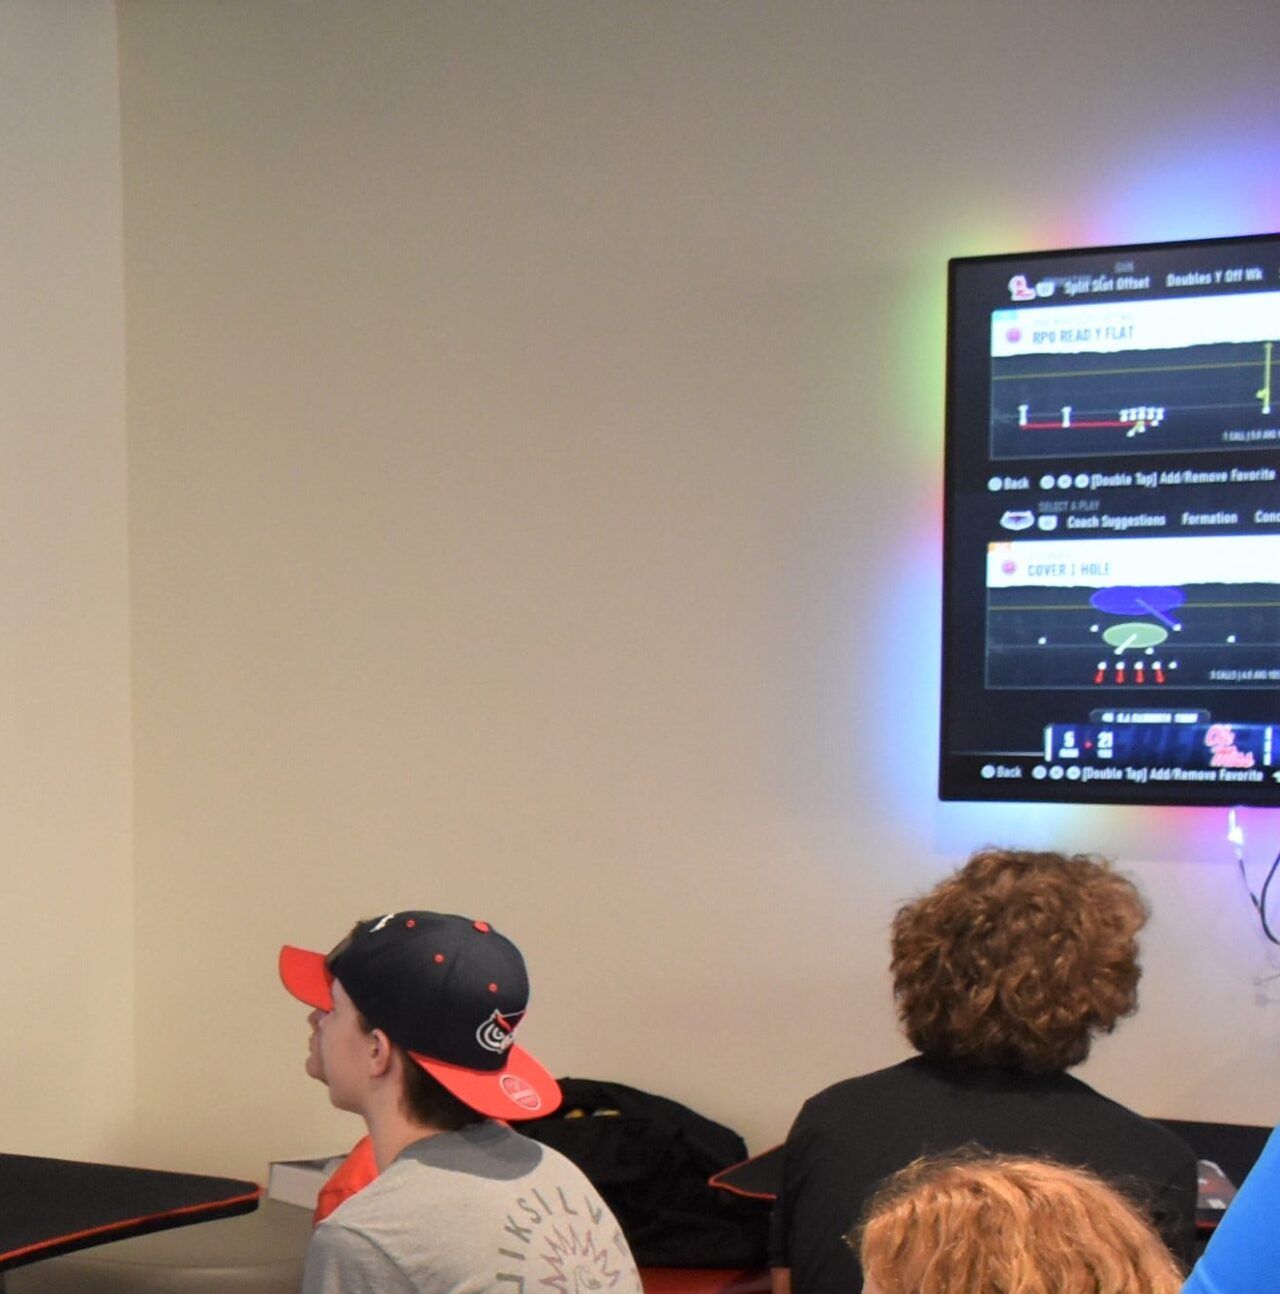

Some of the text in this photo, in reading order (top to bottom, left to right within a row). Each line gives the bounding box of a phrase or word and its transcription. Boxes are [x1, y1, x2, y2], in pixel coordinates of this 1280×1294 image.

[1064, 278, 1090, 296] Split
[1092, 274, 1114, 293] Slot
[1115, 275, 1151, 291] Offset
[1166, 271, 1212, 288] Doubles
[1225, 269, 1243, 283] Off
[1060, 329, 1091, 343] READ
[1095, 328, 1102, 341] Y
[1105, 326, 1134, 340] FLAT
[1003, 476, 1030, 490] Back
[1230, 467, 1276, 482] Favorite
[1066, 515, 1100, 530] Coach
[1101, 513, 1167, 531] Suggestions
[1181, 511, 1239, 527] Formation
[1027, 563, 1066, 577] COVER
[1080, 561, 1111, 575] HOLE
[995, 766, 1022, 779] Back
[1218, 768, 1264, 782] Favorite
